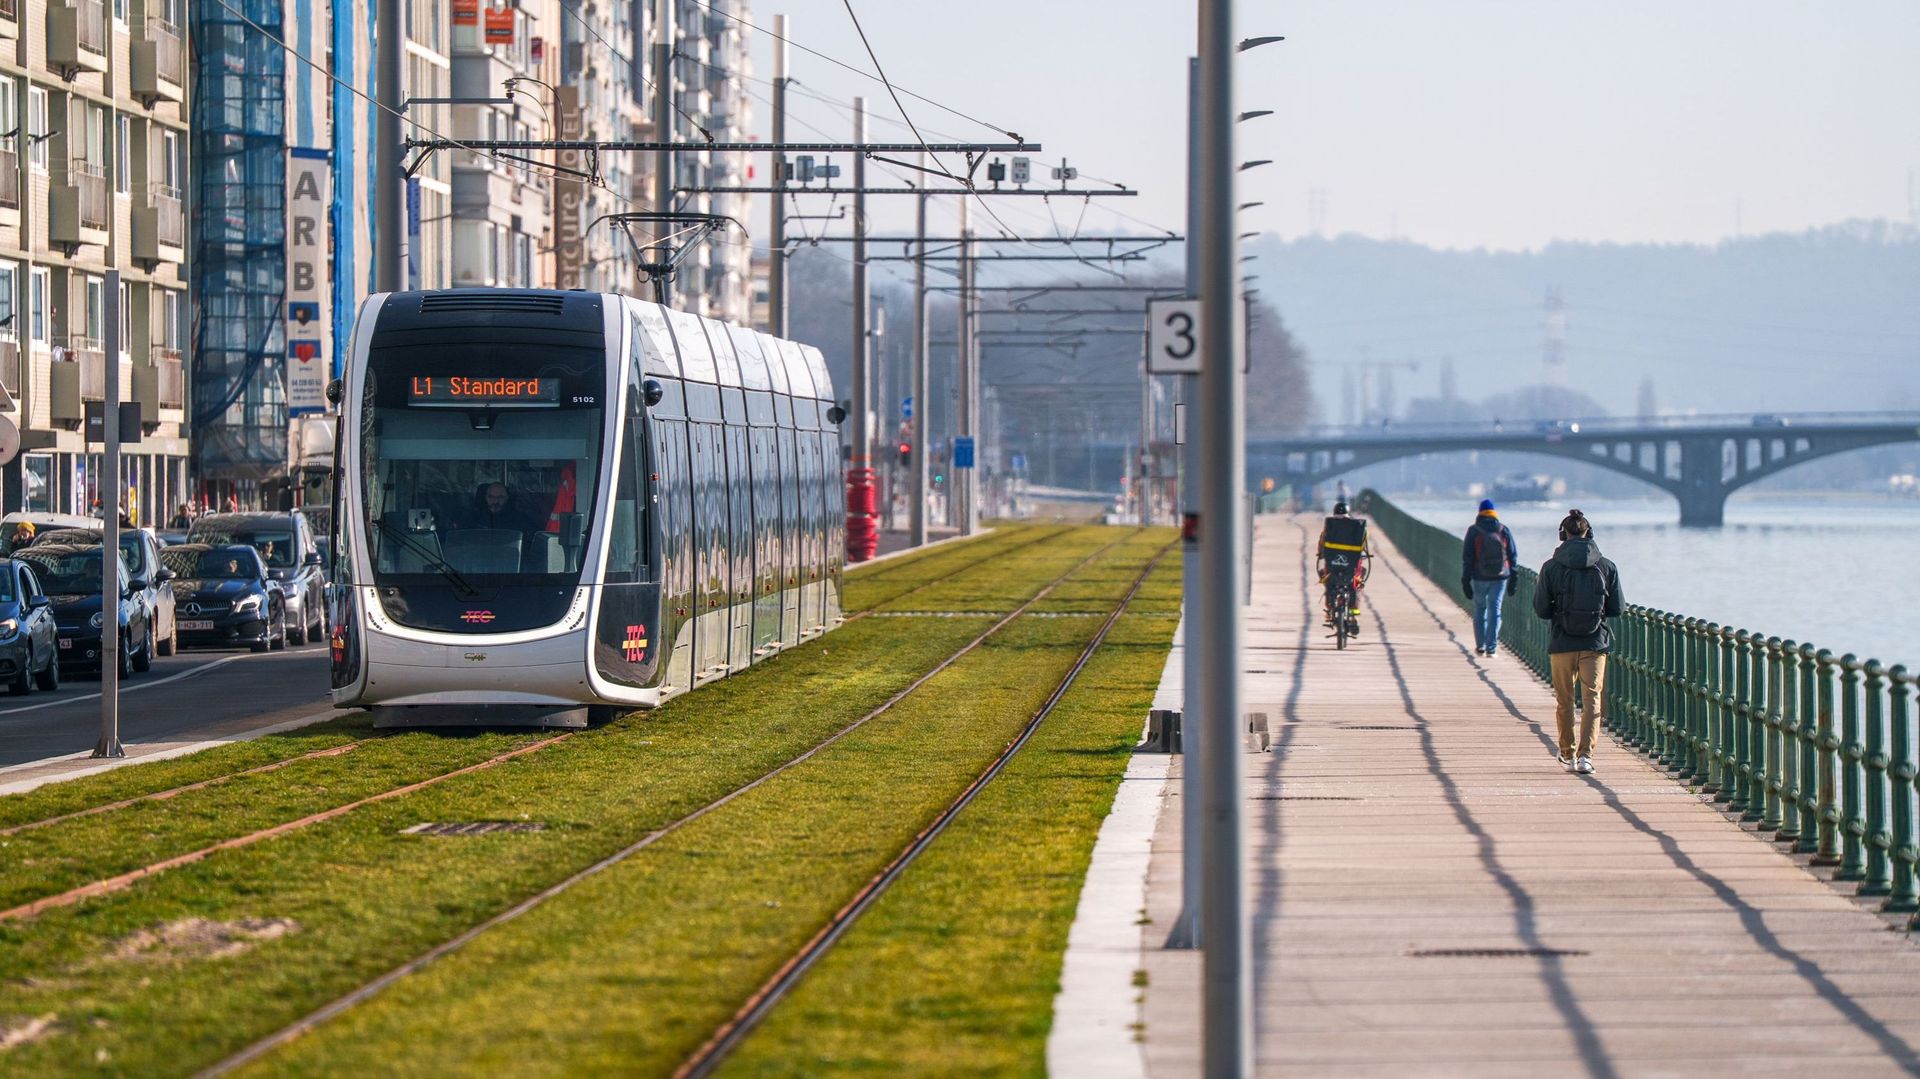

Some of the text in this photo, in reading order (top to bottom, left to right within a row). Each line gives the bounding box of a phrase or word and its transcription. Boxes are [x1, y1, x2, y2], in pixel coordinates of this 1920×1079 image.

[293, 170, 321, 291] ARB
[562, 191, 578, 290] ercure
[1165, 311, 1195, 360] 3
[413, 376, 539, 395] L1 Standard
[464, 610, 492, 624] TEC
[626, 623, 646, 662] TEC
